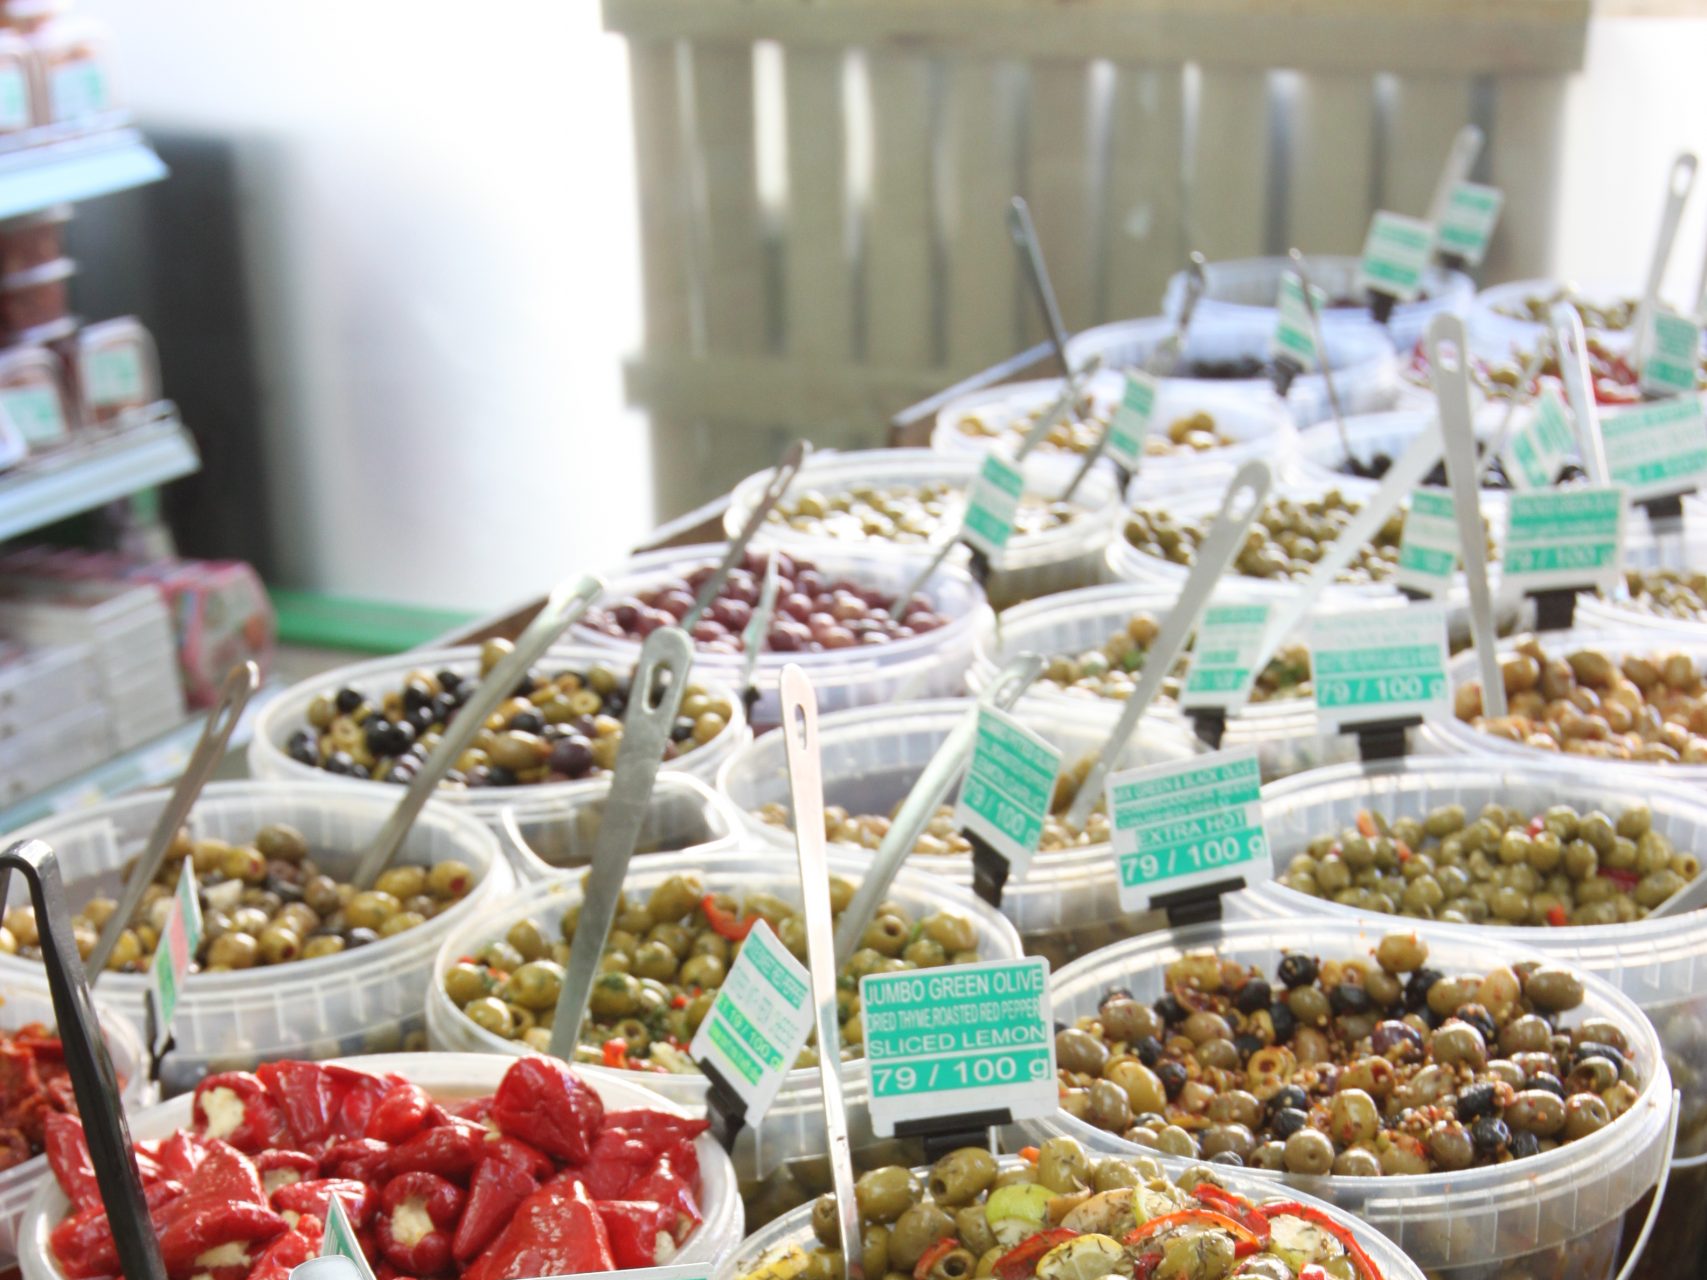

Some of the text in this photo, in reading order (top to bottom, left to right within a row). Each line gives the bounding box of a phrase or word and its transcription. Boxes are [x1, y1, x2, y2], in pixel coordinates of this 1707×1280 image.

[1377, 676, 1423, 701] 100
[1138, 819, 1201, 847] EXTRA
[1206, 810, 1246, 833] HOT
[1122, 854, 1159, 882] 79
[1168, 849, 1176, 873] /
[1188, 836, 1240, 867] 100
[866, 968, 1044, 1006] JUMBO GREEN OLIVE
[867, 1010, 896, 1034] DRIED
[980, 1001, 999, 1022] RED
[869, 1025, 1046, 1057] SLICED LEMON
[873, 1056, 1049, 1092] 79 / 100 g
